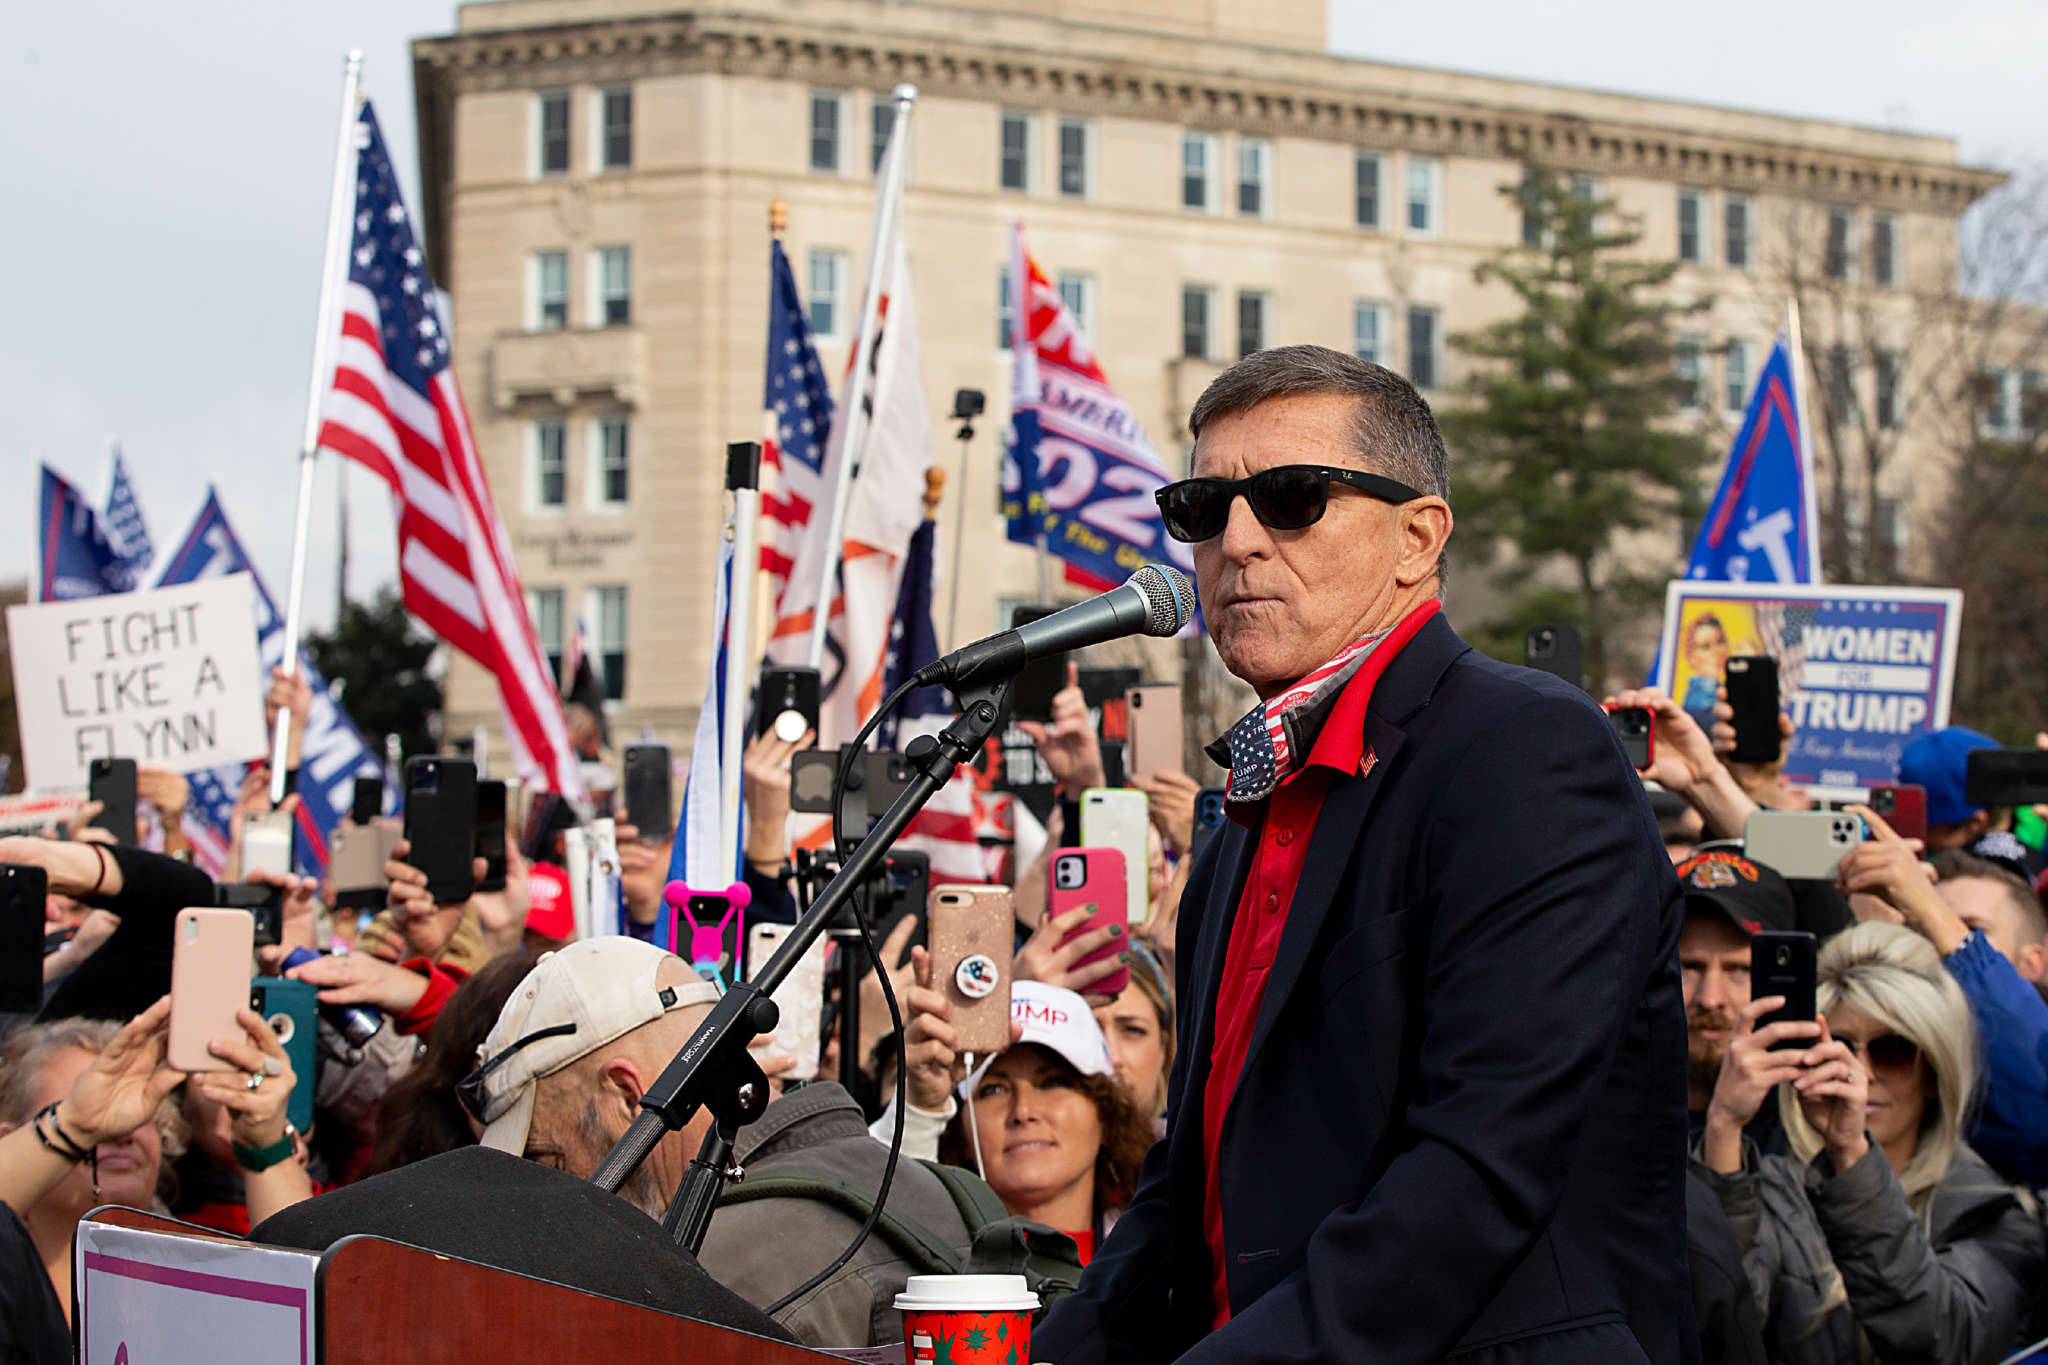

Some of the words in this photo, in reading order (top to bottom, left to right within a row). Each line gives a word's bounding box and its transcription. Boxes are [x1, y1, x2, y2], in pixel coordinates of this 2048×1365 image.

[65, 602, 201, 663] FIGHT
[1802, 625, 1936, 664] WOMEN
[57, 661, 169, 717] LIKE
[193, 654, 226, 697] A
[1838, 669, 1871, 685] FOR
[1788, 690, 1926, 734] TRUMP
[1233, 764, 1258, 779] RUMP
[1011, 1004, 1068, 1025] UMP
[683, 1026, 715, 1063] HAMILTON
